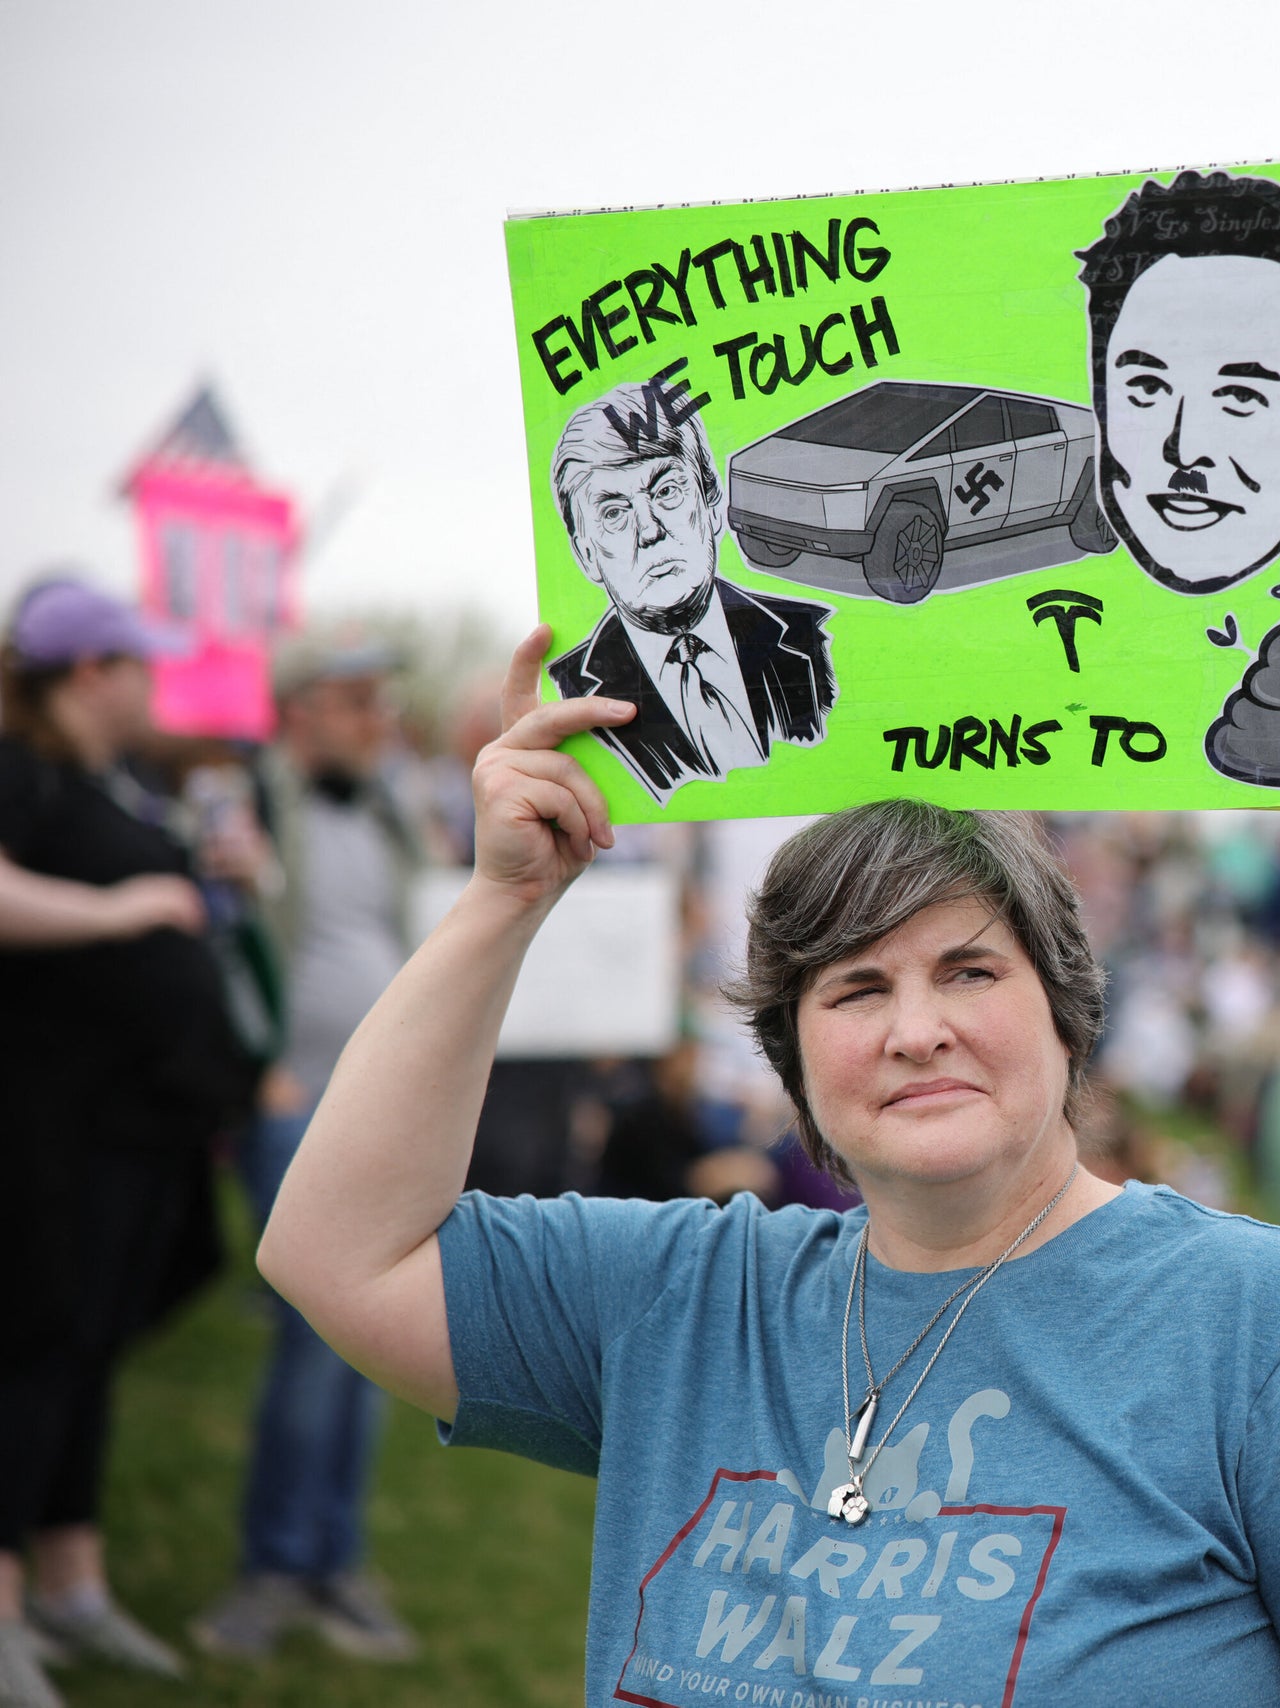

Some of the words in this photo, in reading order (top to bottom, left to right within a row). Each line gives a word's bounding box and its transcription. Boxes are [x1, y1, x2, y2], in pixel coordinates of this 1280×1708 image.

[532, 217, 891, 395] EVERYTHING
[603, 357, 712, 452] WE
[713, 296, 901, 400] TOUCH
[883, 713, 1063, 772] TURNS
[1089, 714, 1167, 767] TO
[692, 1500, 1022, 1600] HARRIS
[694, 1589, 942, 1685] WALZ
[679, 1669, 731, 1697] YOUR
[735, 1681, 786, 1708] OWN
